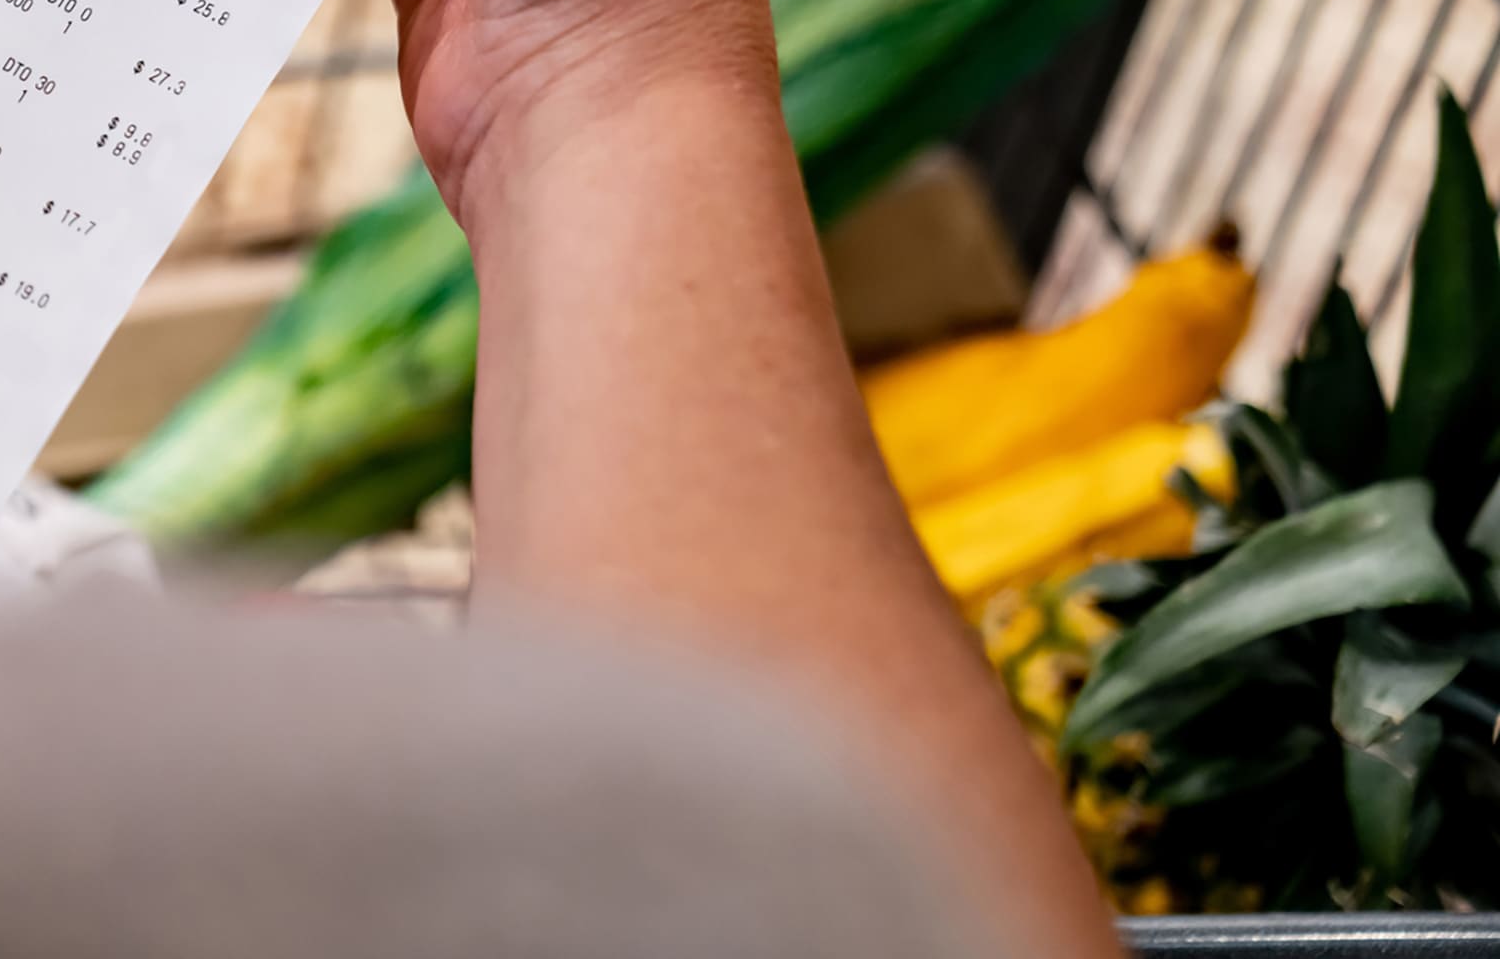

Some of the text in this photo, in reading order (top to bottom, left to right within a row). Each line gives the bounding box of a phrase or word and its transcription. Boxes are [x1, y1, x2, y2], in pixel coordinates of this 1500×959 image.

[148, 67, 186, 95] 27.3
[1, 56, 32, 82] DTO
[34, 75, 56, 95] 30
[123, 123, 152, 147] 9.8
[111, 140, 142, 165] 8.9
[60, 208, 96, 235] 17.7
[14, 280, 50, 308] 19.0
